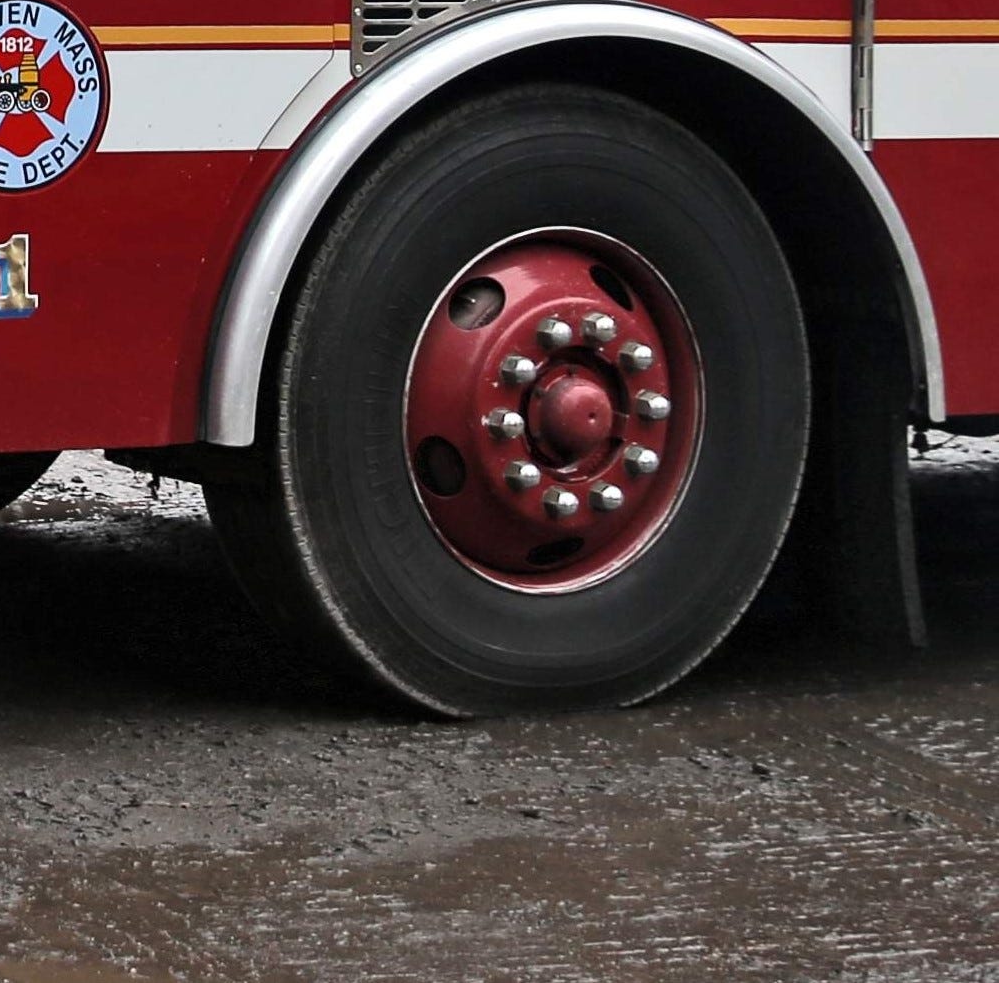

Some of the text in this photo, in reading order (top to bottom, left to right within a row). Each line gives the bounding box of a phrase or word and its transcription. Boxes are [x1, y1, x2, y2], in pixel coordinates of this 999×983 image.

[0, 37, 34, 52] 1812
[54, 21, 98, 100] MASS.
[22, 133, 85, 184] DEPT.
